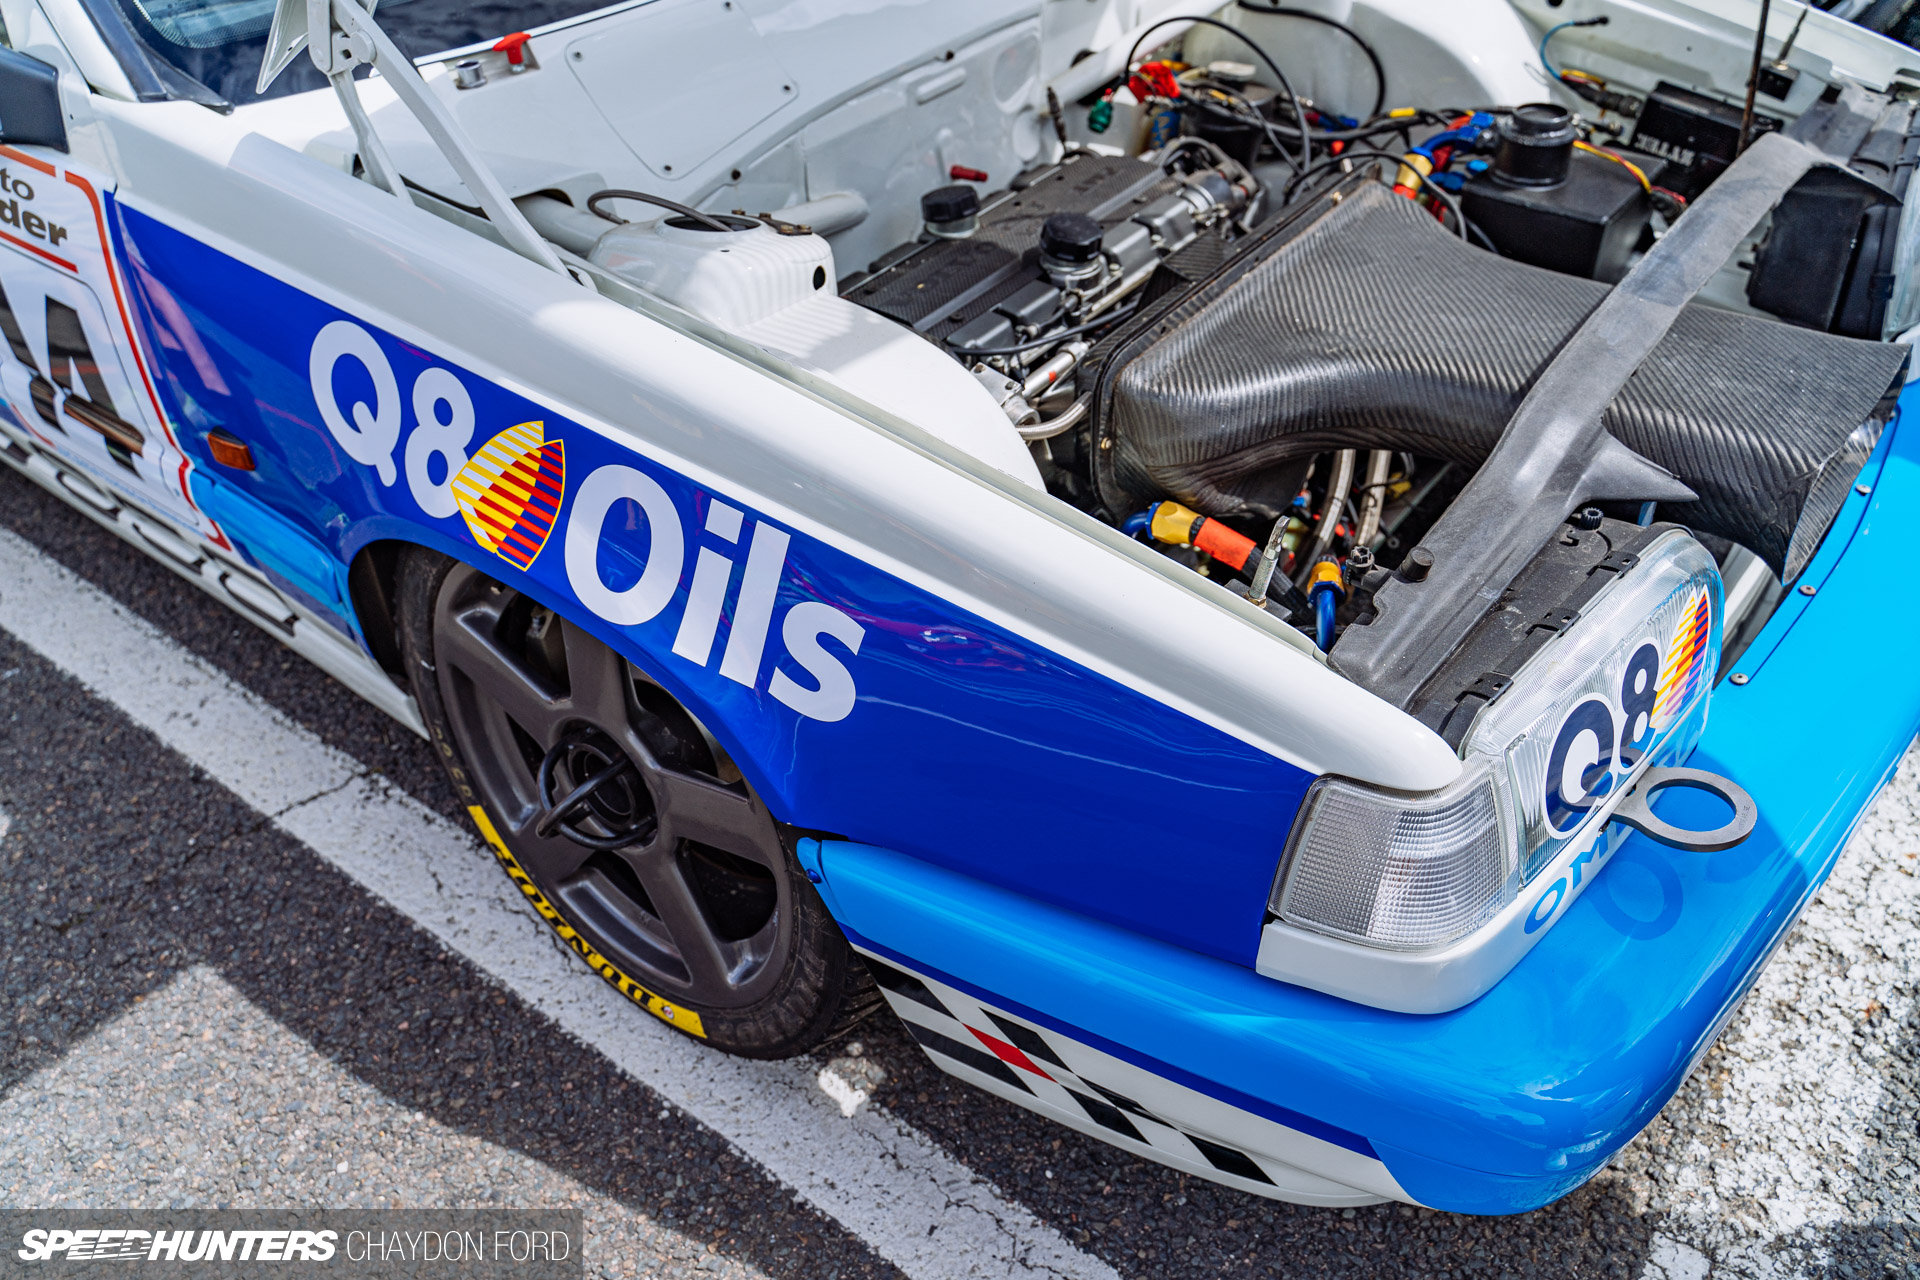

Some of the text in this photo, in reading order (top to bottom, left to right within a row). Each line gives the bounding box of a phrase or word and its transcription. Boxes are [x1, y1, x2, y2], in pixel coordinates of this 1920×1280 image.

[309, 320, 476, 519] Q8
[565, 465, 867, 722] Oils
[1545, 640, 1660, 836] Q8
[490, 842, 655, 1007] DUNLOP
